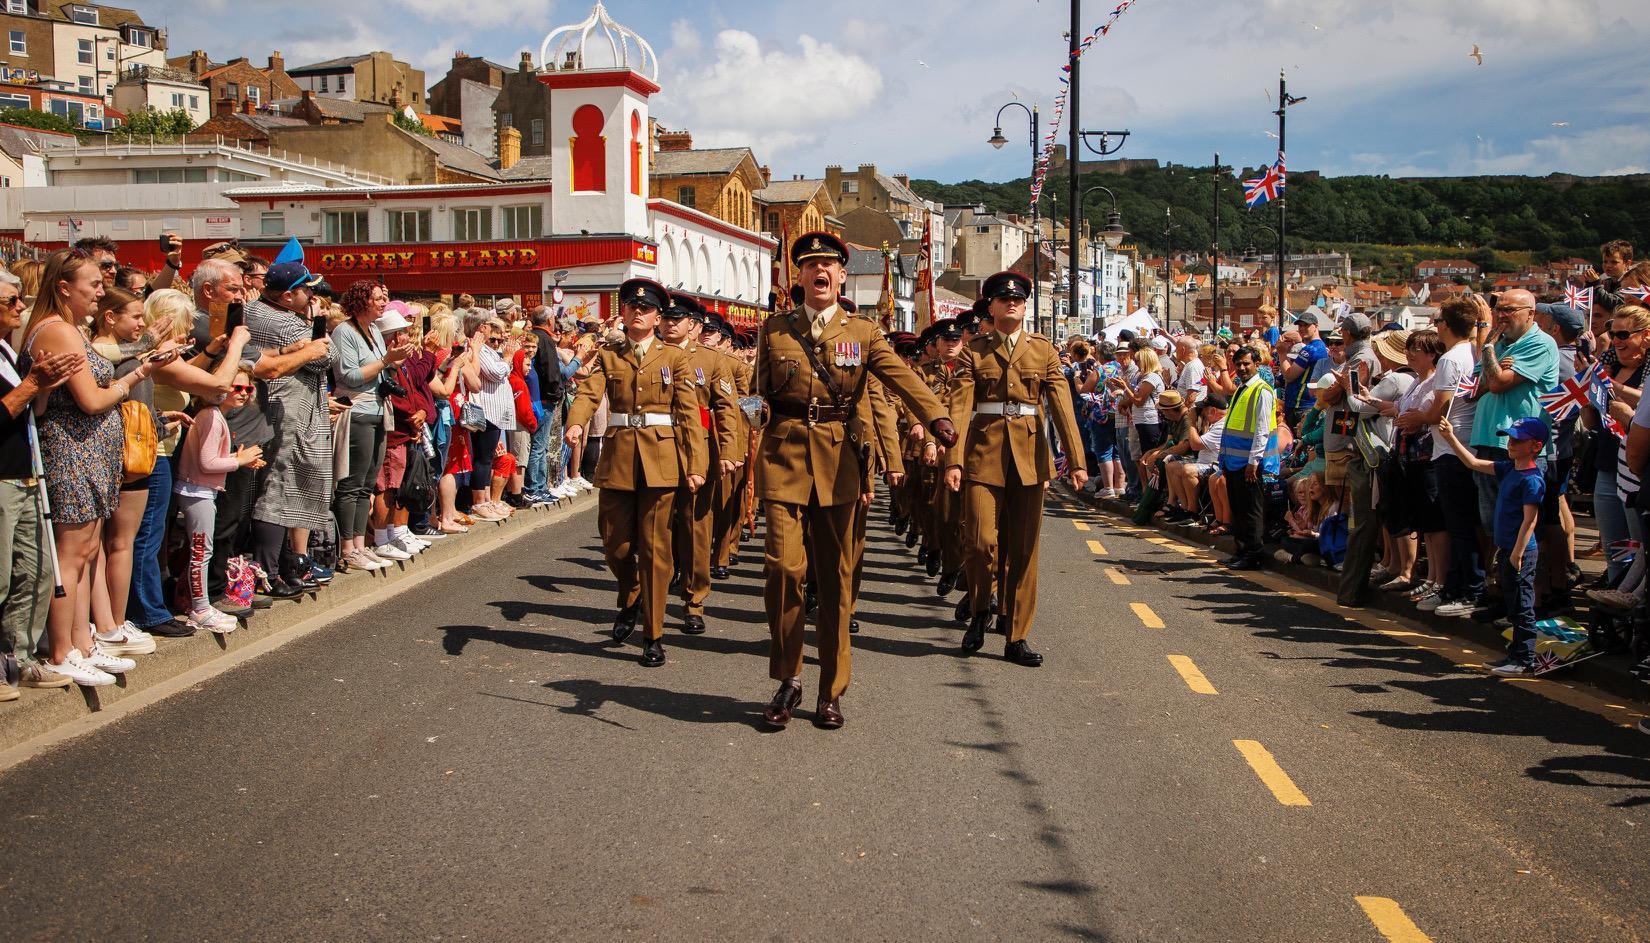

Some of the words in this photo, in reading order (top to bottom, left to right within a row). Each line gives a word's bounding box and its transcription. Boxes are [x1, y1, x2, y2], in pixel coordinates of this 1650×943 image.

[321, 252, 414, 270] CONEY
[429, 249, 539, 267] ISLAND
[191, 563, 203, 598] MICKEY
